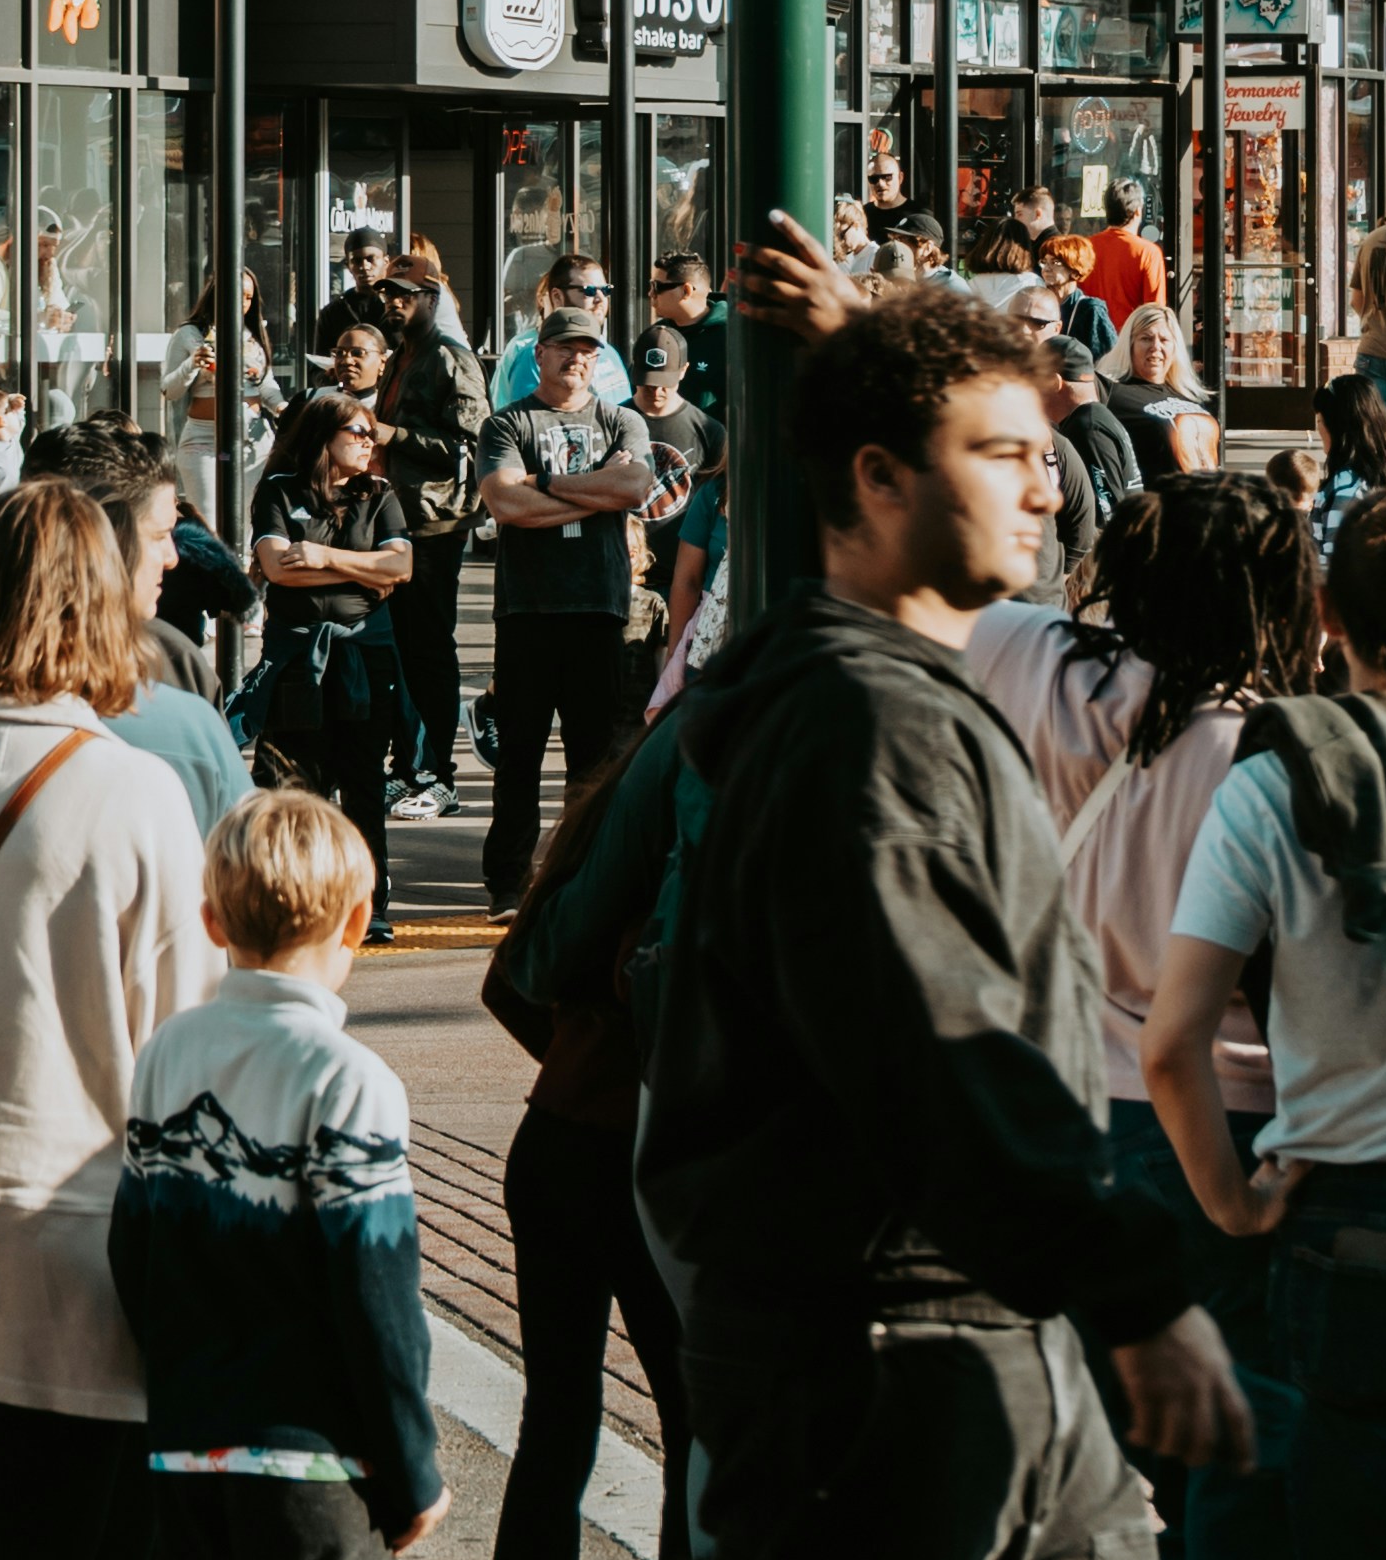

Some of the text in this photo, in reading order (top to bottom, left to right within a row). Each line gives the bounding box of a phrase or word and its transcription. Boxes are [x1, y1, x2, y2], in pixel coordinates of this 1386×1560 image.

[634, 26, 704, 50] shake bar
[1224, 102, 1287, 129] Jewelry
